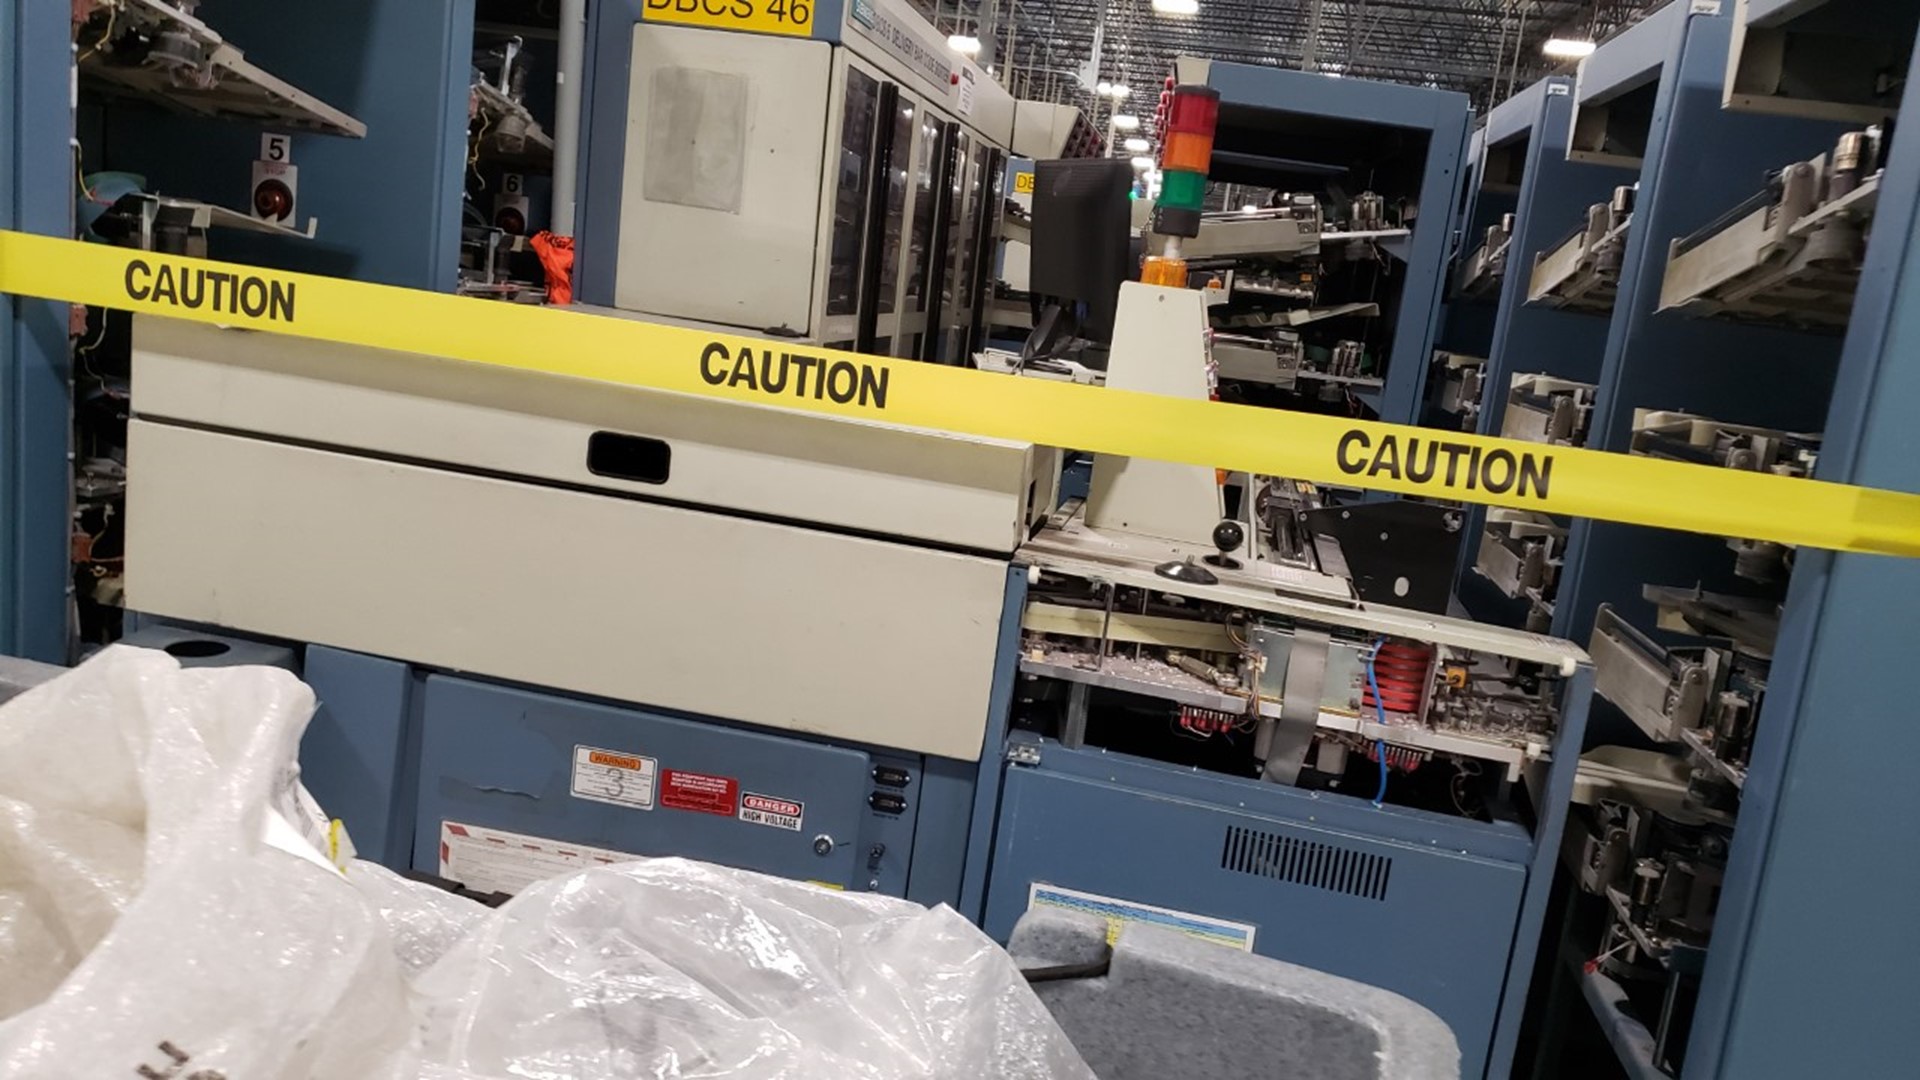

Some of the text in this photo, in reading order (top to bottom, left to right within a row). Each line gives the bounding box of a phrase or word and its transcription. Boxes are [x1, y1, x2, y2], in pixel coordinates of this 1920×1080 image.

[766, 0, 809, 25] 46
[892, 26, 914, 57] DELIVERY
[269, 137, 284, 160] 5
[507, 175, 519, 192] 6
[125, 259, 295, 322] CAUTION
[700, 342, 889, 409] CAUTION
[1337, 429, 1553, 500] CAUTION
[594, 753, 636, 768] WARNING
[749, 798, 796, 813] DANGER
[743, 810, 797, 829] HIGH VOLTAGE
